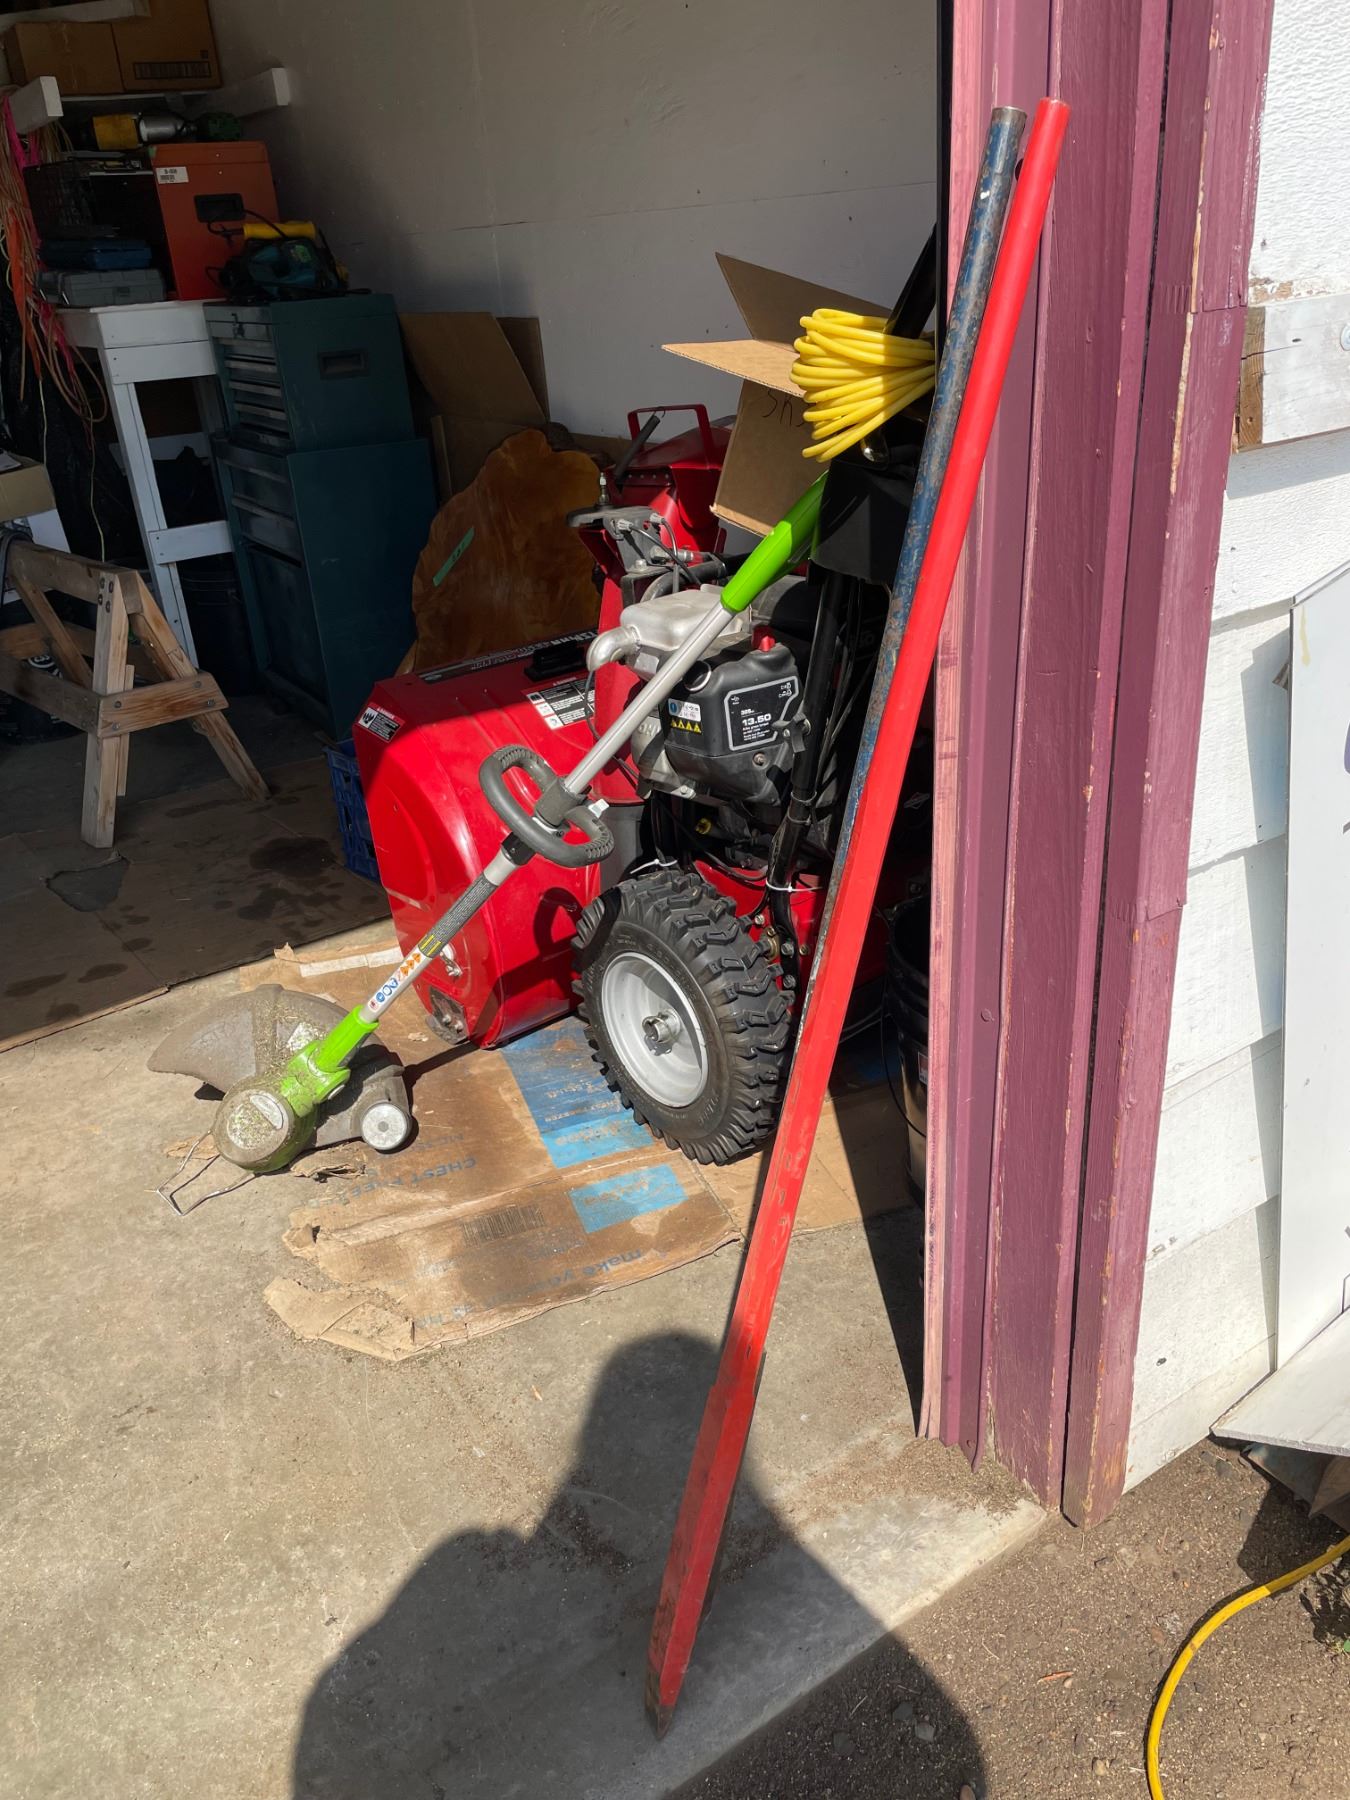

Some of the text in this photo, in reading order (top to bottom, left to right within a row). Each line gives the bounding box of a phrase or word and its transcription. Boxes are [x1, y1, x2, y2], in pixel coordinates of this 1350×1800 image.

[742, 713, 771, 726] 13.50
[411, 1156, 477, 1185] CHEST
[582, 1247, 642, 1277] make
